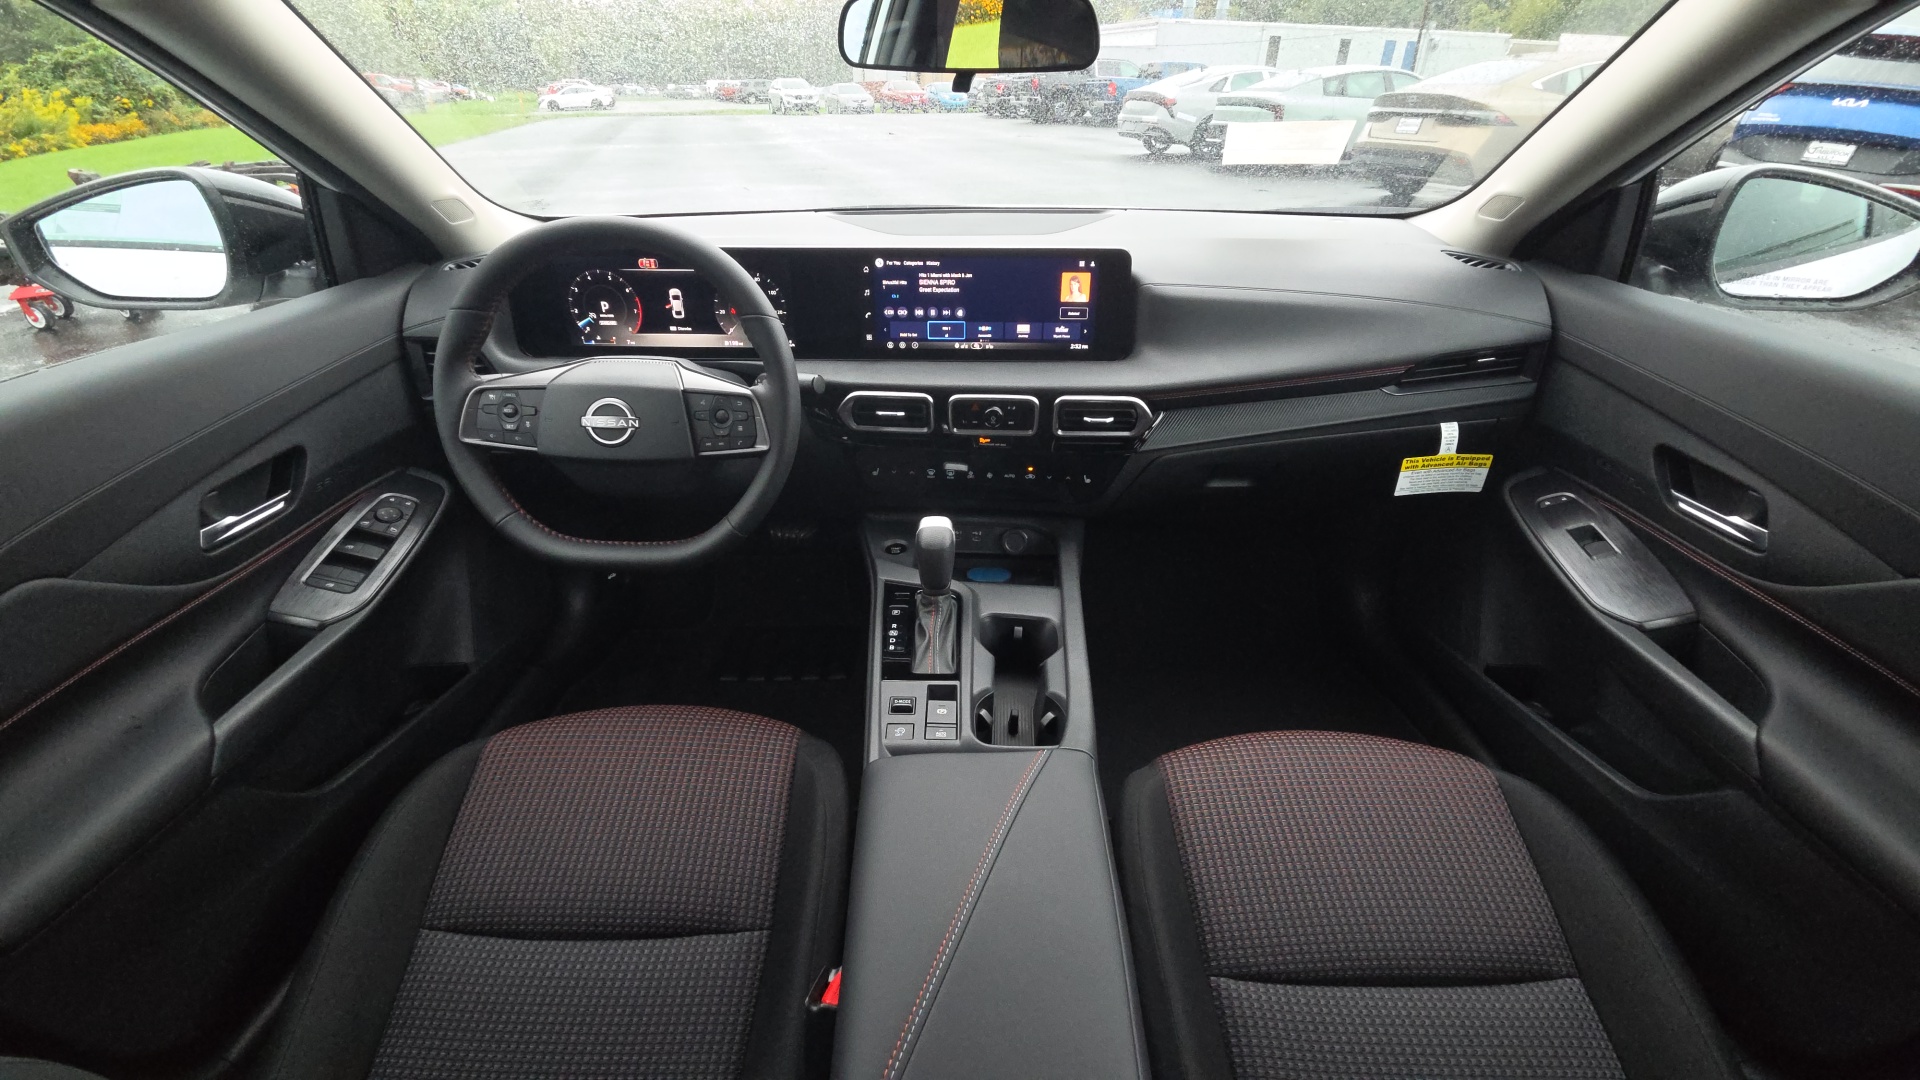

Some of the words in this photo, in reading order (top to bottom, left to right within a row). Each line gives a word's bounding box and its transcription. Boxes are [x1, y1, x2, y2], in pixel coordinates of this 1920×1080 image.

[1783, 275, 1811, 284] MIRROR
[1802, 284, 1833, 292] APPEAR
[600, 301, 610, 312] P
[582, 418, 639, 428] NISSAN
